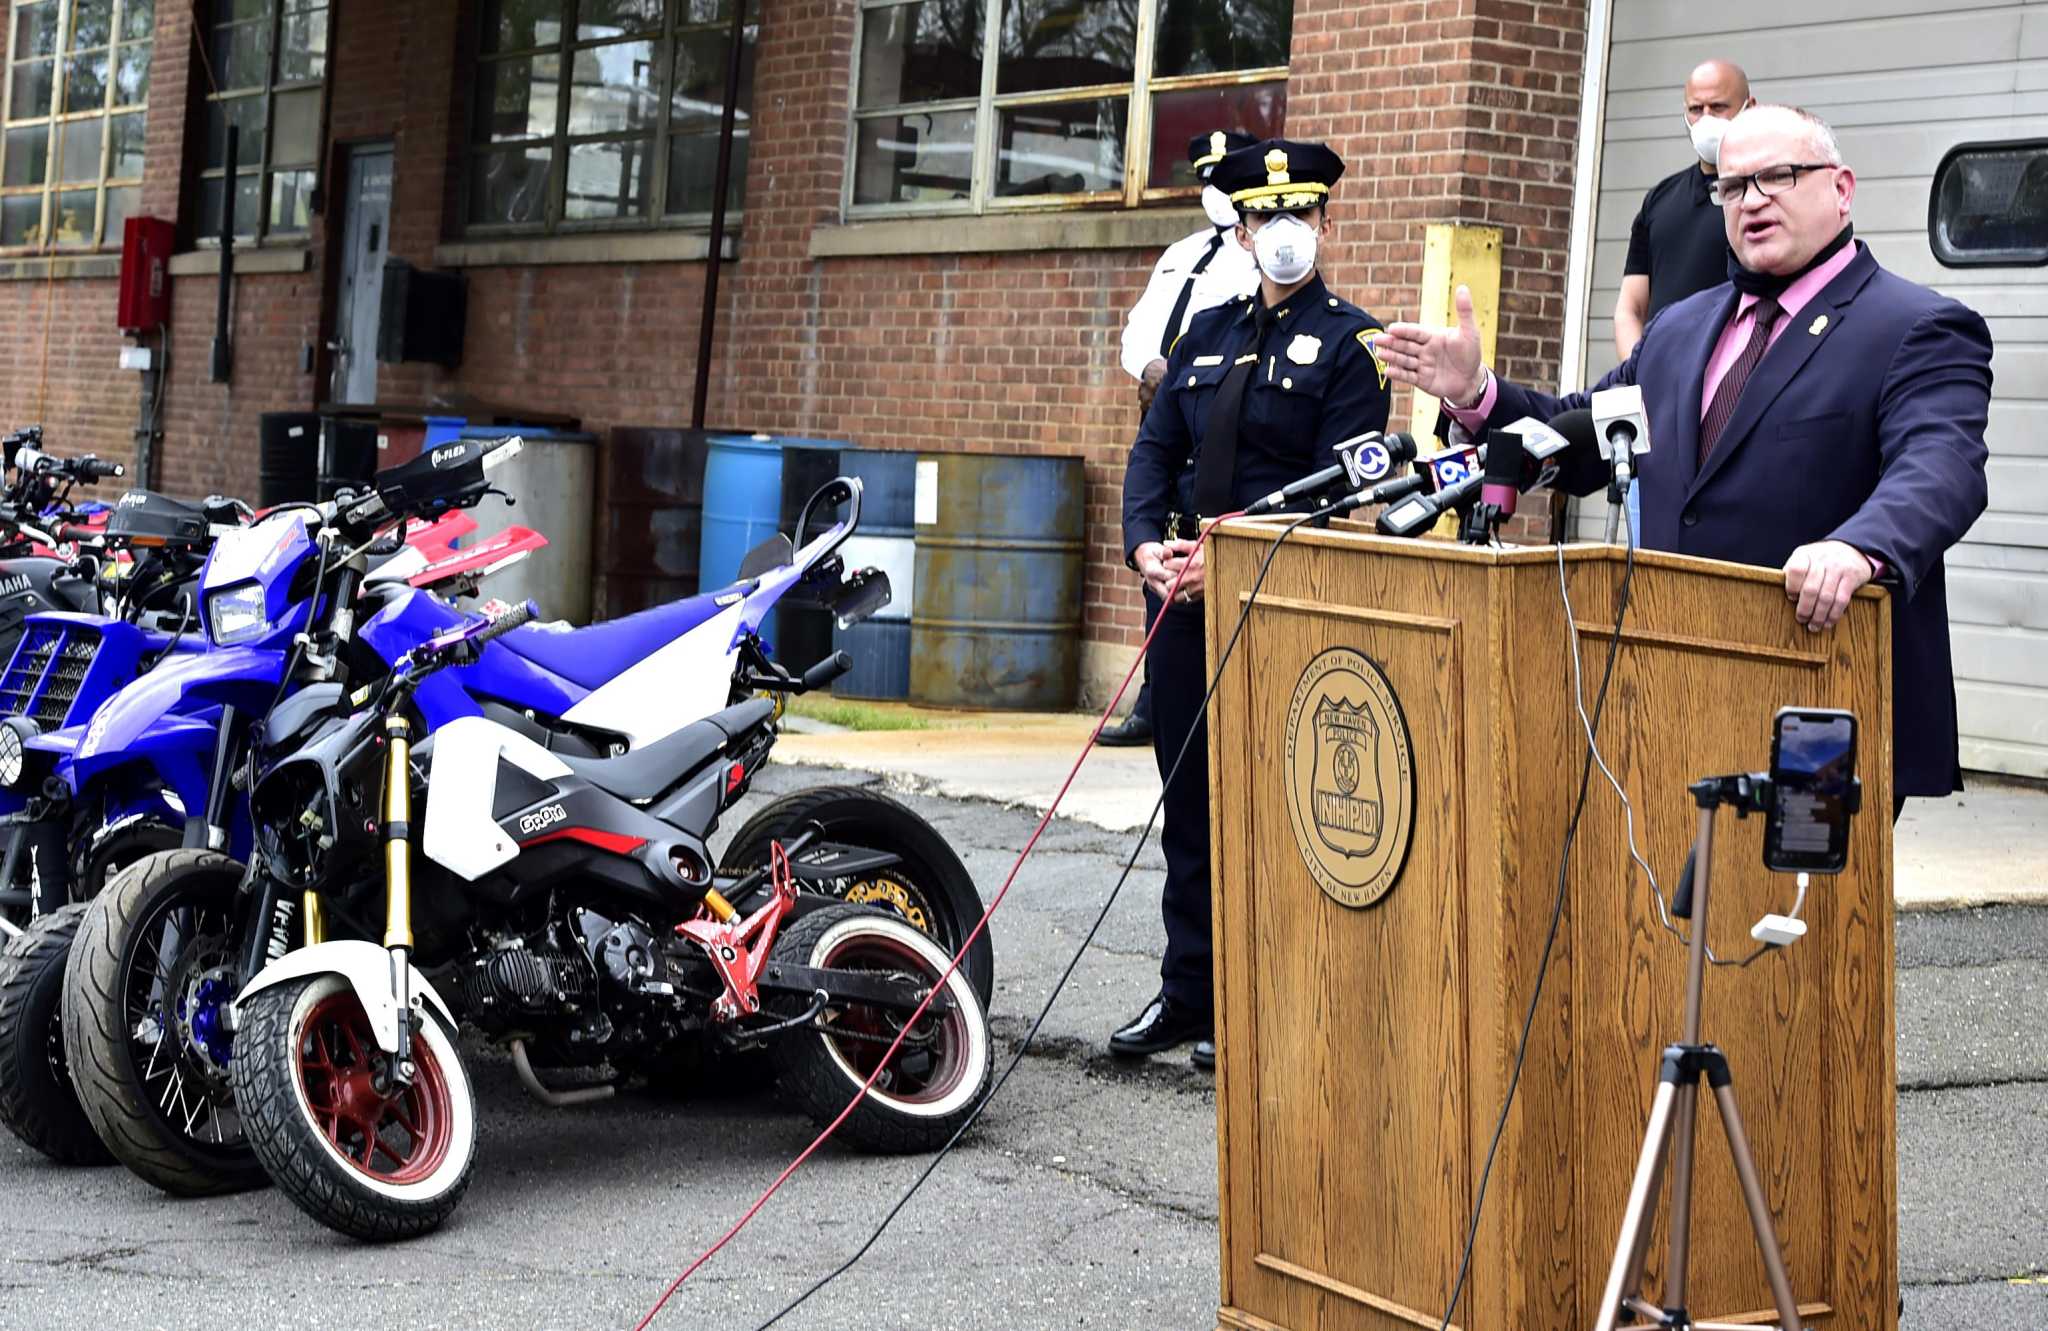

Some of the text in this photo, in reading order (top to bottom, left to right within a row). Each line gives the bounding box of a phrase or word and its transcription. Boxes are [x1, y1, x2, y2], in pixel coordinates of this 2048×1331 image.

[1287, 655, 1408, 782] DEPARTMENT OF POLICE SERVICE
[1324, 713, 1367, 729] NEW HAVEN
[520, 804, 567, 834] GROM
[1319, 793, 1376, 835] NHPD
[30, 845, 41, 923] YAMA
[1304, 847, 1324, 879] CITY
[1341, 890, 1361, 903] NEW
[1364, 869, 1392, 902] HAVEN
[265, 899, 295, 967] MAHA
